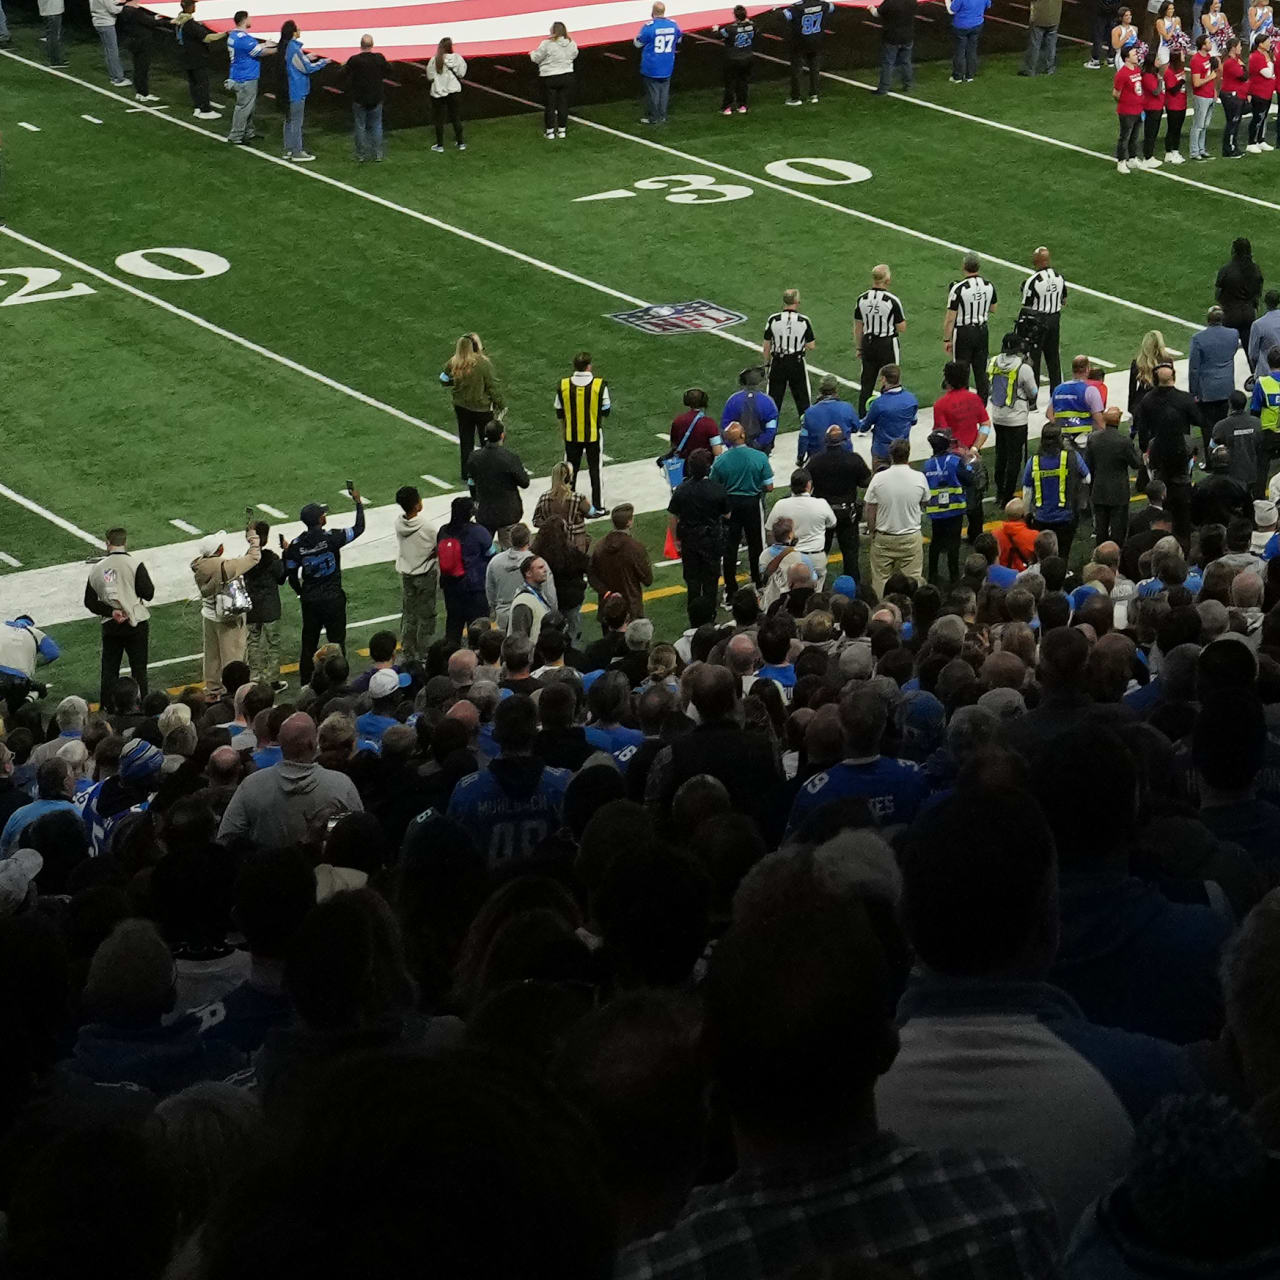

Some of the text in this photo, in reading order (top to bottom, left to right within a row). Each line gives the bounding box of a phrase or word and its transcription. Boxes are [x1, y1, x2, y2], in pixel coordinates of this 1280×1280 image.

[653, 34, 675, 54] 97
[632, 156, 874, 206] 30
[868, 304, 881, 315] 75
